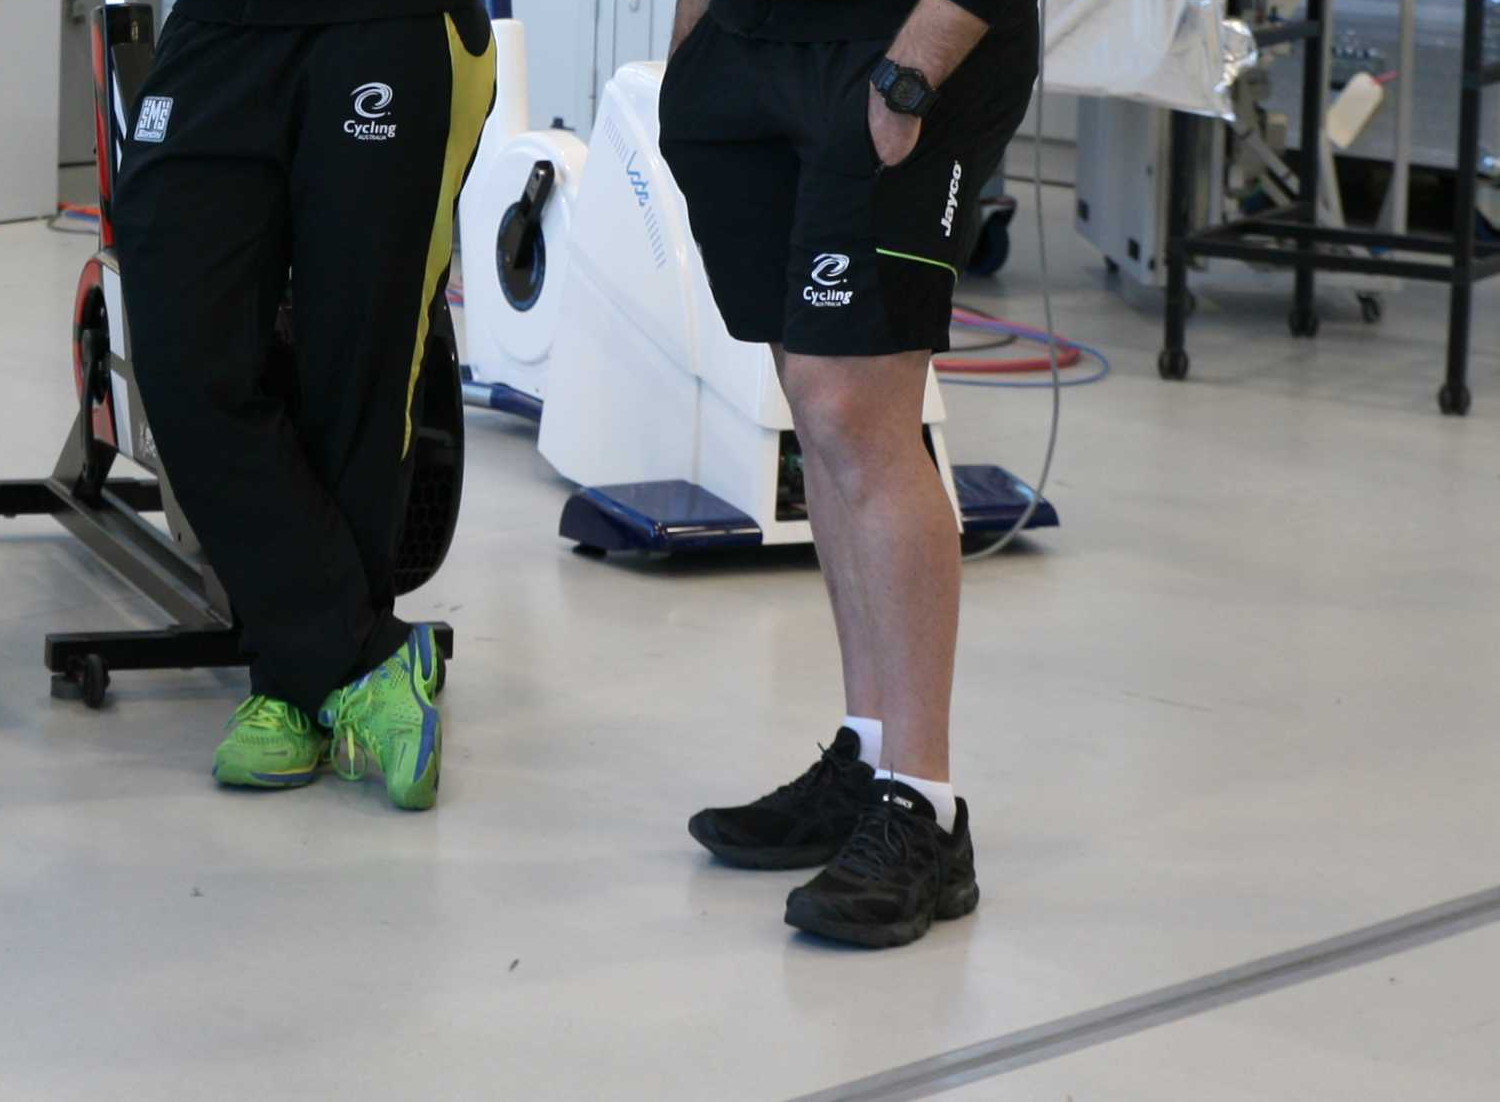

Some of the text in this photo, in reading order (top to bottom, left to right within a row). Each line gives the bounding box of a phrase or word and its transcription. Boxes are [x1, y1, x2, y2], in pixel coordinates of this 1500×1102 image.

[139, 100, 171, 130] SMS
[344, 120, 397, 138] Cycling
[940, 162, 962, 237] Jayco
[803, 286, 853, 305] Cycling
